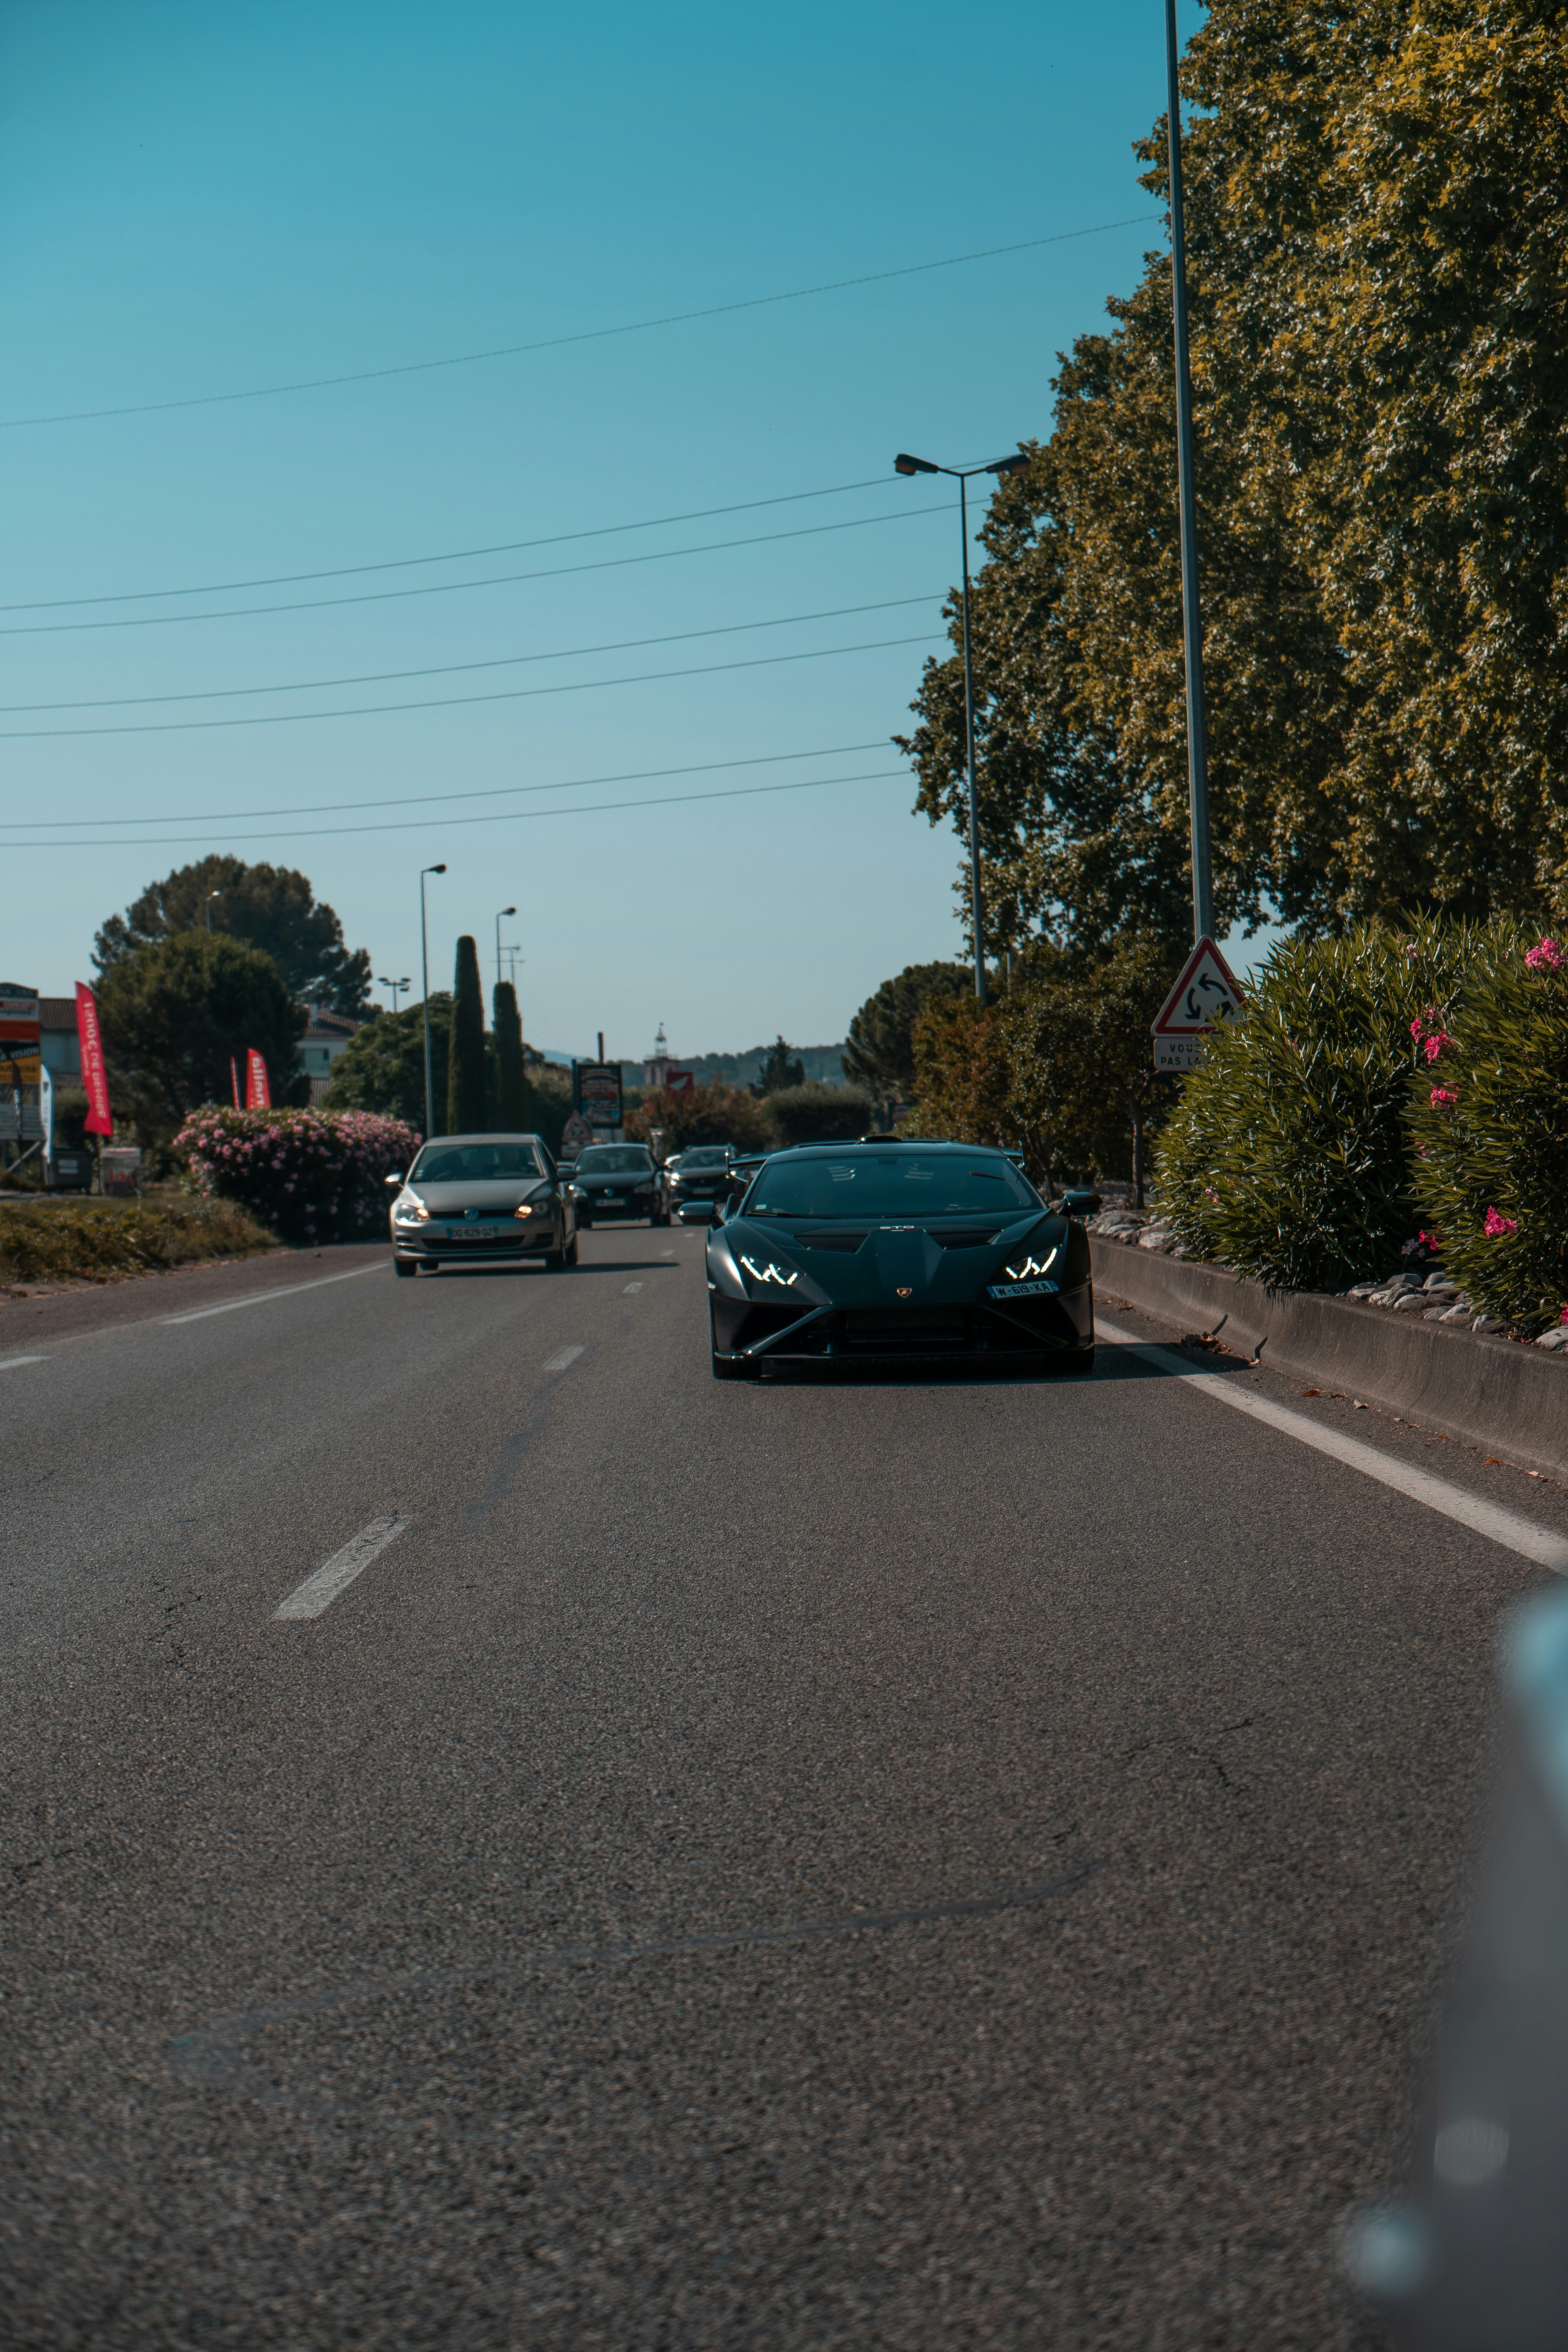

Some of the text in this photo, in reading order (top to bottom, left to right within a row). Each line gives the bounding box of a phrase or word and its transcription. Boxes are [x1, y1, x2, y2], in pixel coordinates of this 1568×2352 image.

[10, 1046, 38, 1058] VISION
[1170, 1044, 1201, 1053] VOUS
[1161, 1057, 1181, 1065] PAS
[995, 1282, 1051, 1296] W-619-KA
